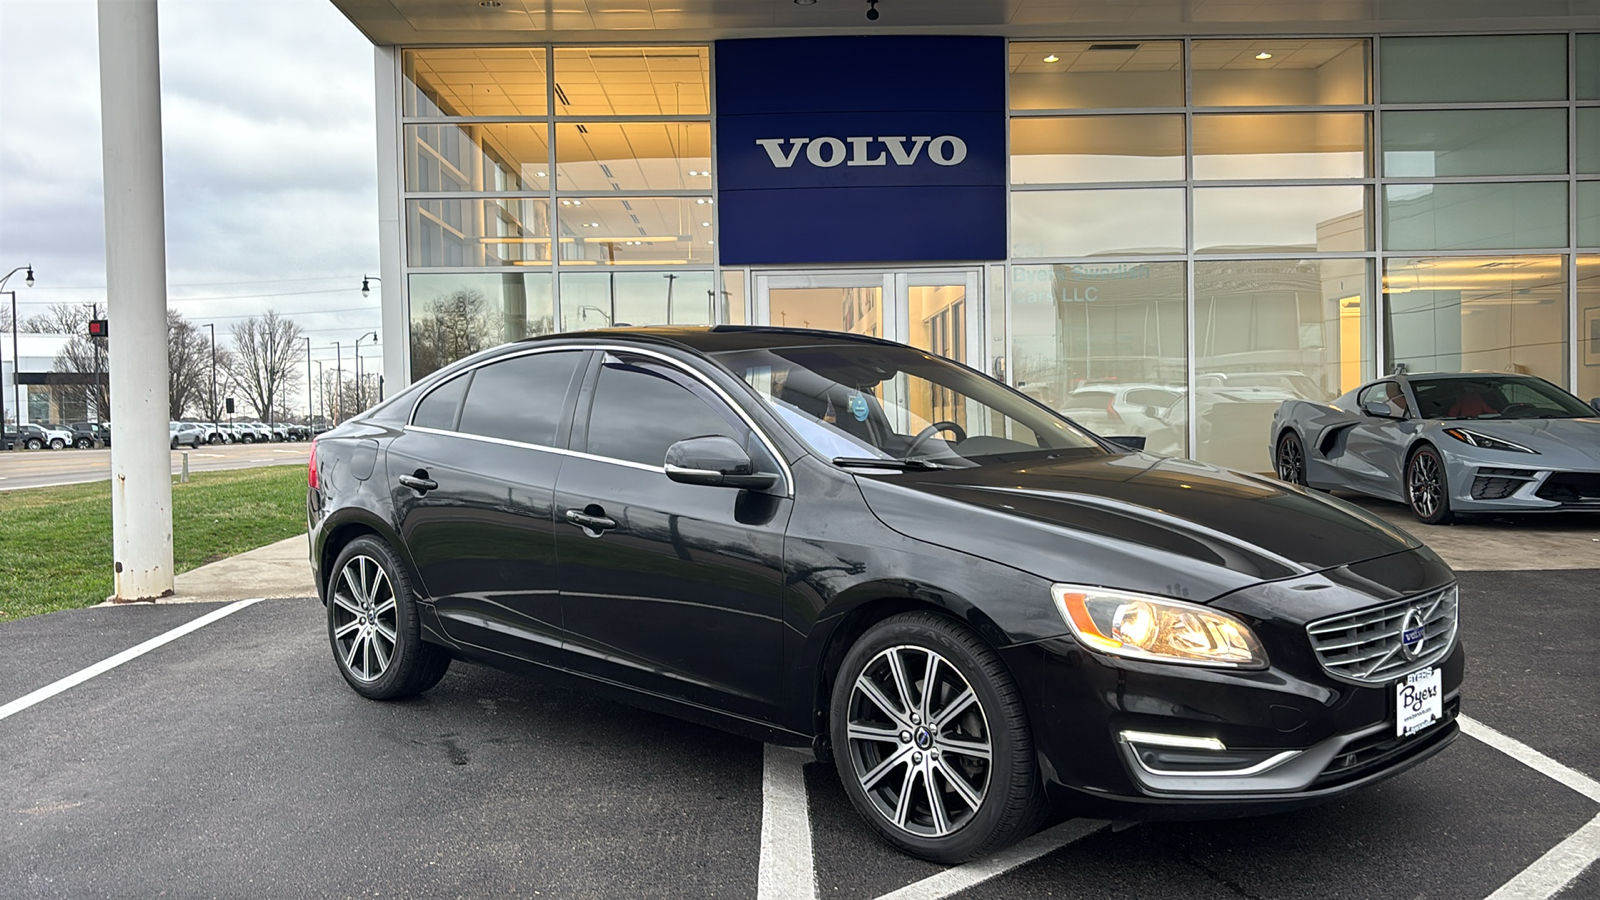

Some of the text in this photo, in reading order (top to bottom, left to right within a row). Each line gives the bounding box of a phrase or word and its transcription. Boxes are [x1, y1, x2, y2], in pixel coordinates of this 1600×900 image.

[756, 135, 968, 168] VOLVO
[1013, 264, 1150, 284] Byers Swedish
[1013, 286, 1098, 303] Cars LLC
[1399, 685, 1438, 712] Byers
